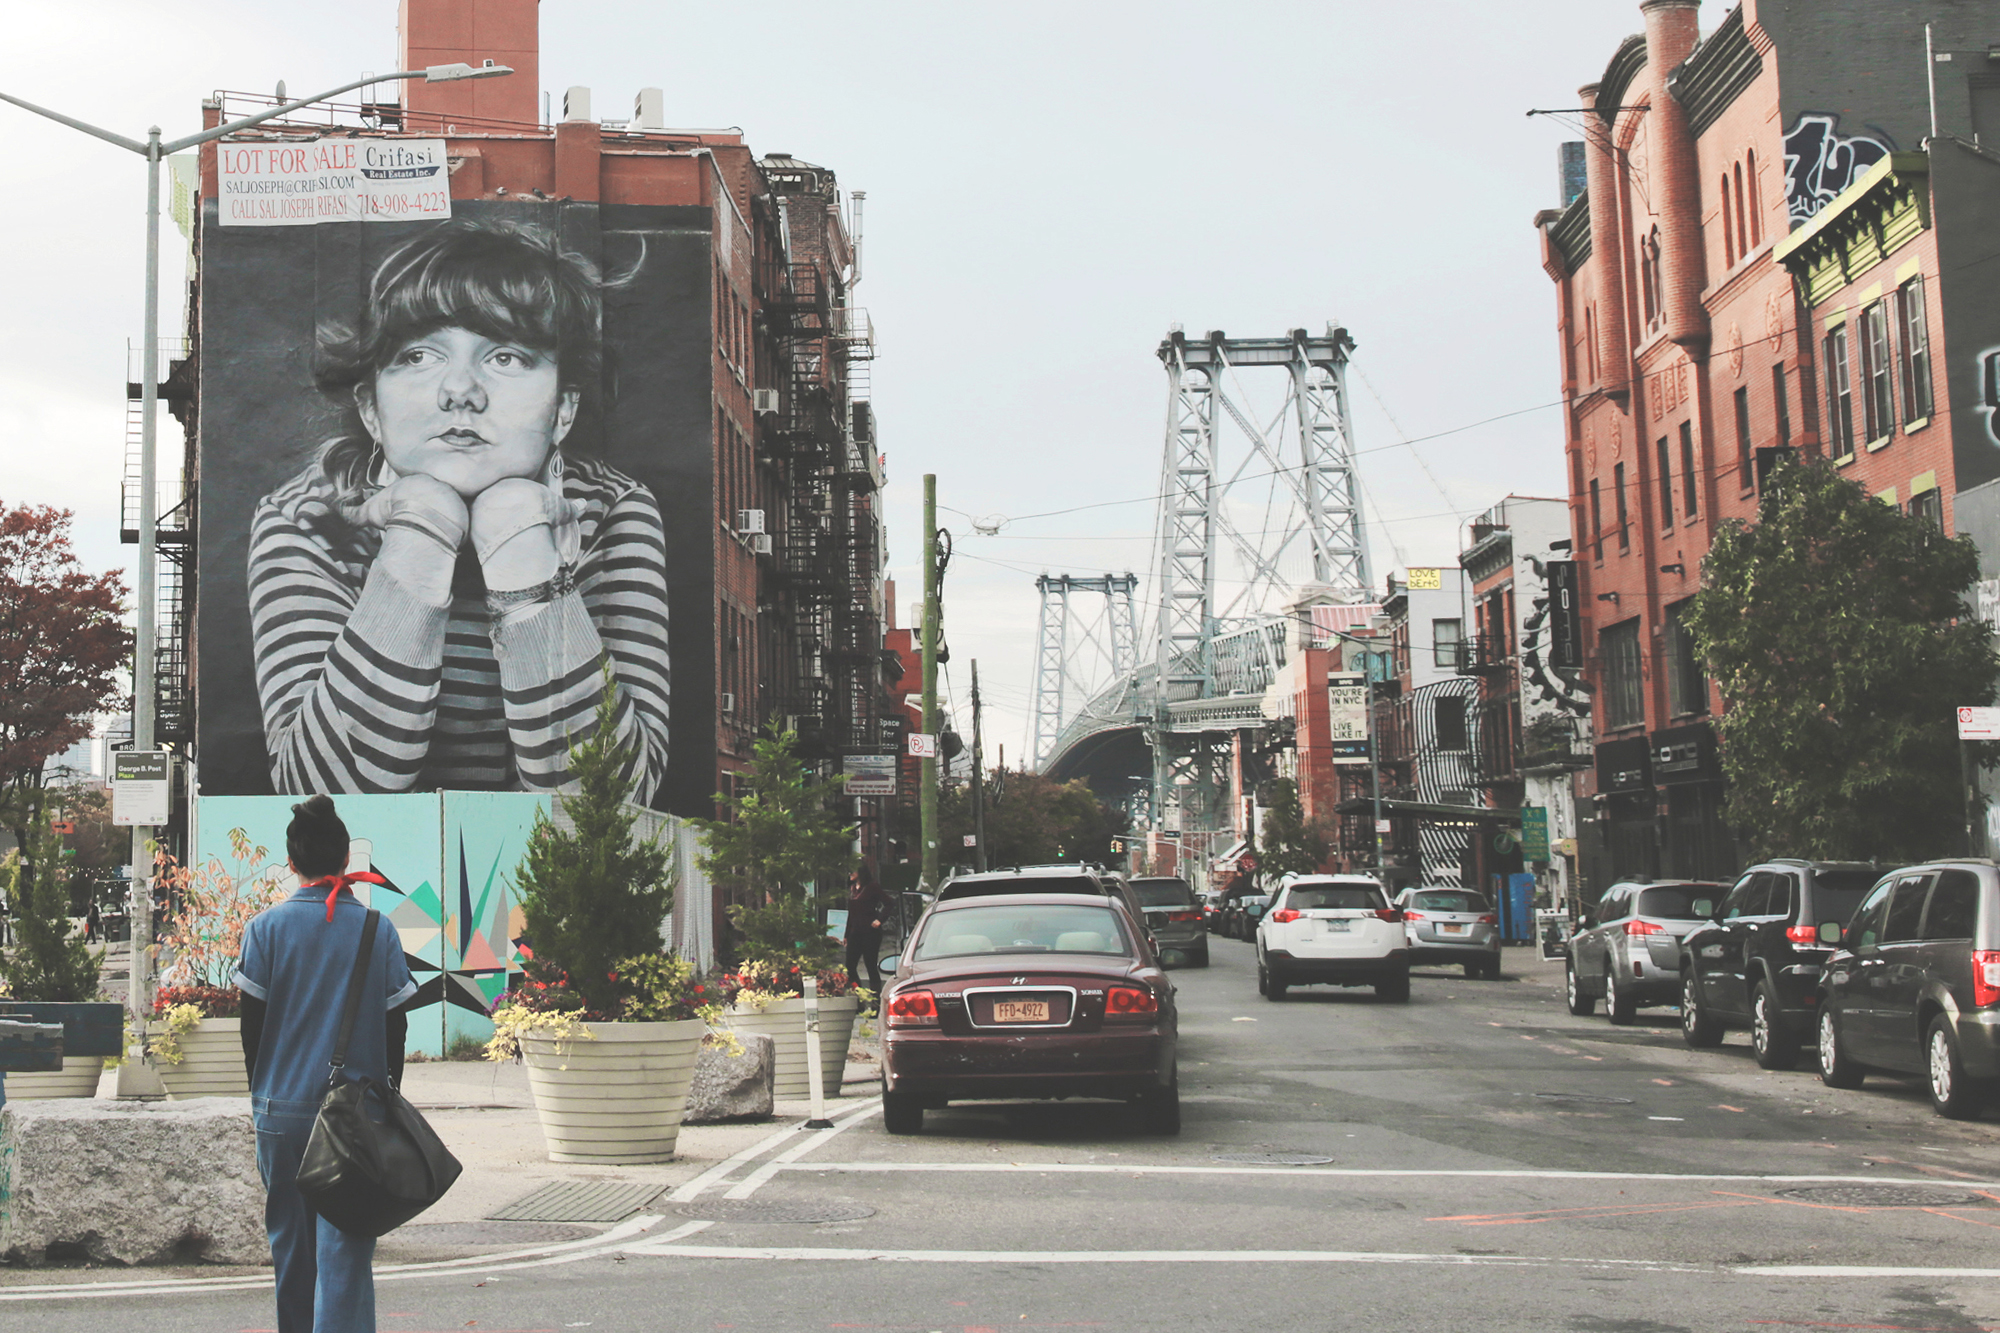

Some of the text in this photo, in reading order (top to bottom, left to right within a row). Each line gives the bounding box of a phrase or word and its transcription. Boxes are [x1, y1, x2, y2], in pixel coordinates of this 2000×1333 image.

[223, 144, 357, 174] LOT FOR SALE
[366, 146, 433, 167] Crifasi
[369, 168, 431, 179] Real Estate Inc.
[226, 175, 355, 197] SALJOSEPH@CRIFSI.COM
[232, 195, 348, 218] CALL SAL JOSEPH RIFASI
[357, 191, 447, 215] 718-908-4223
[1409, 569, 1437, 578] LOVE
[1331, 688, 1363, 697] YOU'RE
[1332, 697, 1341, 705] IN
[1333, 722, 1352, 731] LIVE
[1334, 731, 1353, 739] LIKE
[118, 765, 140, 773] George
